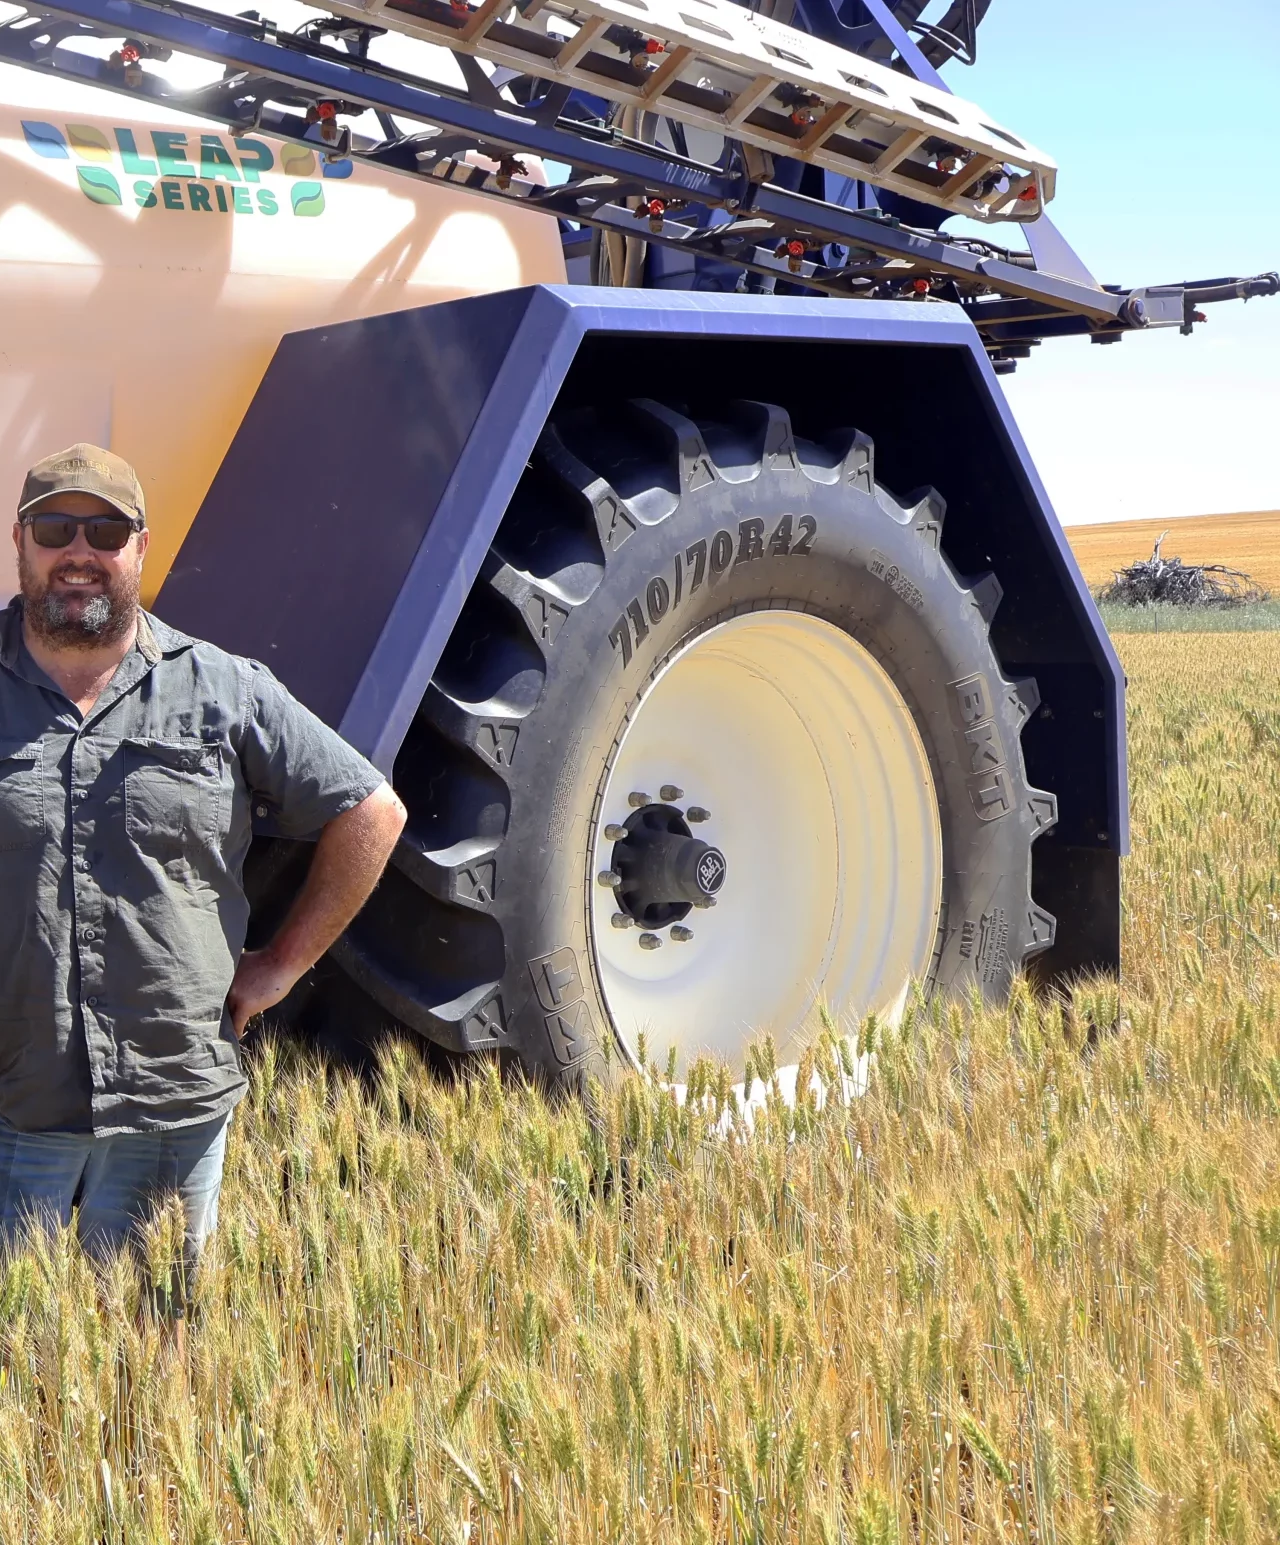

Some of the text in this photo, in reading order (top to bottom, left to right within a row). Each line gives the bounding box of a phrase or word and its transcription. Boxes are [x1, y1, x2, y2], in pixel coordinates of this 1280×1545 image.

[113, 127, 274, 183] LEAP
[133, 180, 279, 215] SERIES
[608, 514, 818, 671] 710/70R42
[955, 677, 1010, 811] BKT
